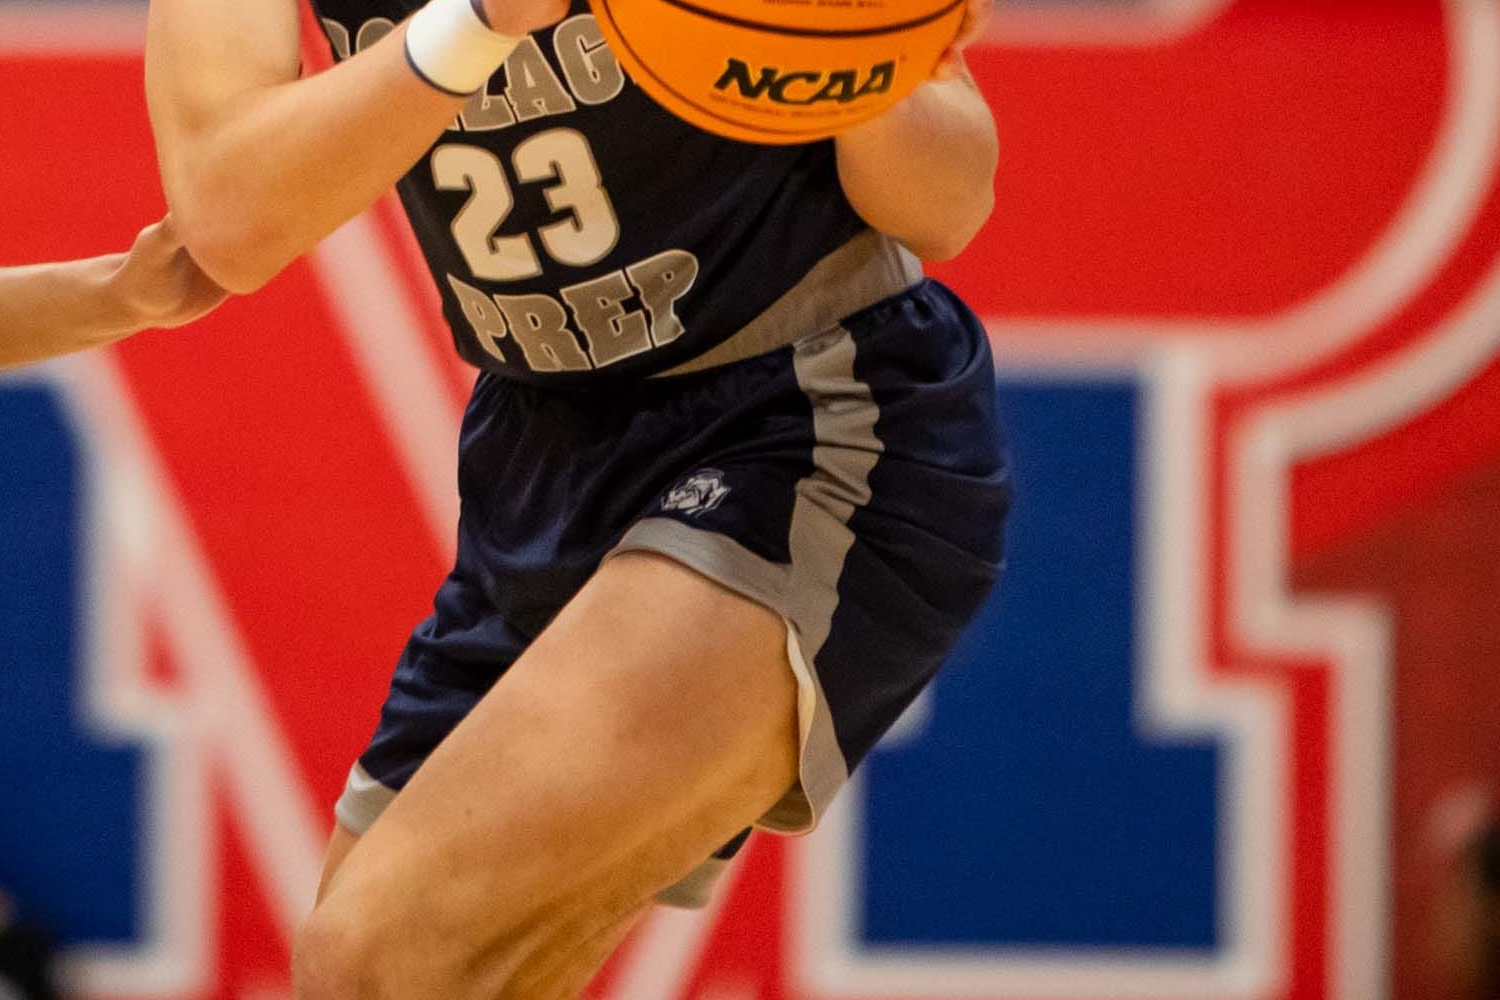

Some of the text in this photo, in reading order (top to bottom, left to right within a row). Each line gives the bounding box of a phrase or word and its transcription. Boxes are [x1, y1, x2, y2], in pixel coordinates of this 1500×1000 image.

[713, 57, 897, 106] NCAA
[430, 126, 620, 282] 23
[446, 248, 700, 373] PREP
